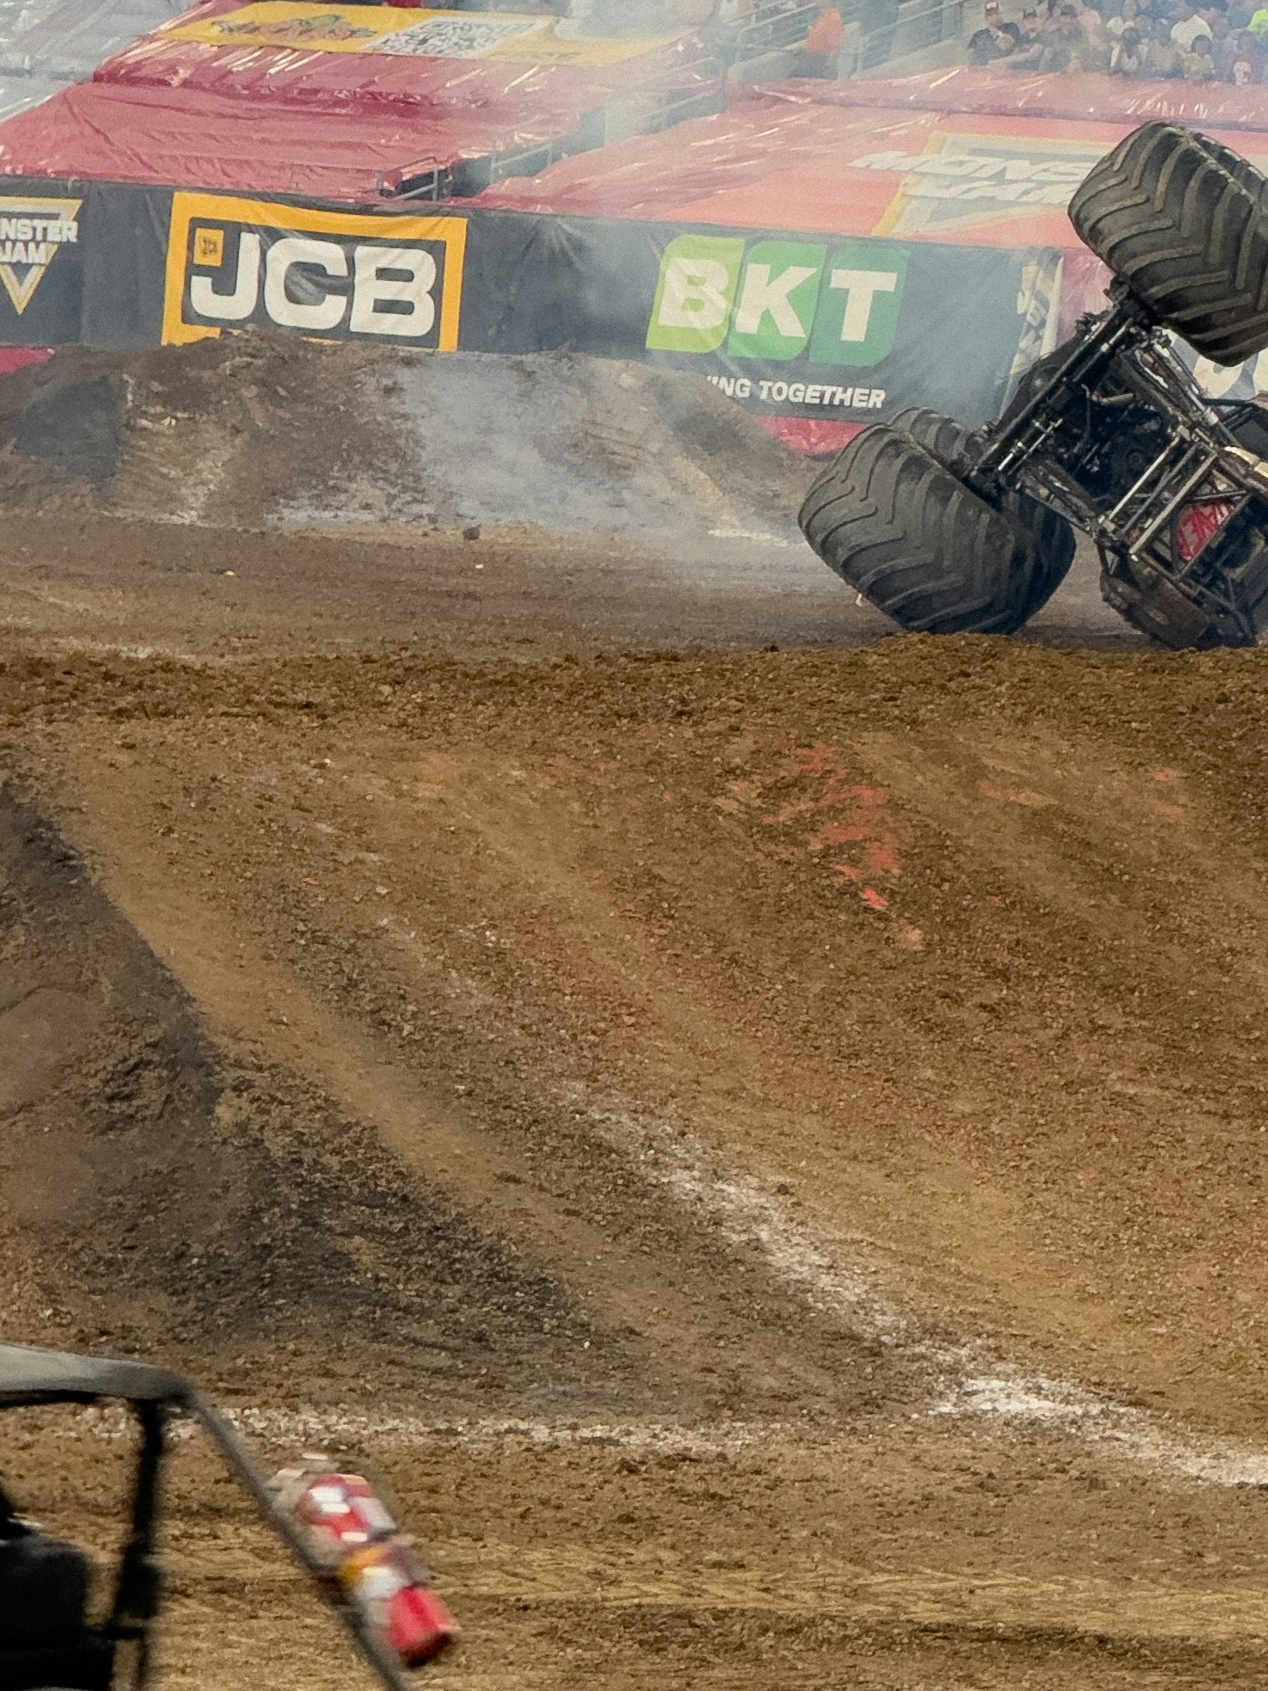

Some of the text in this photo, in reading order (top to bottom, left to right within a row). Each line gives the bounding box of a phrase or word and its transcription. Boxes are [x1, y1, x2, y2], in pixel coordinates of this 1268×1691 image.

[0, 217, 79, 243] NSTER
[190, 231, 437, 338] JCB
[658, 257, 898, 343] BKT
[758, 379, 887, 409] TOGETHER
